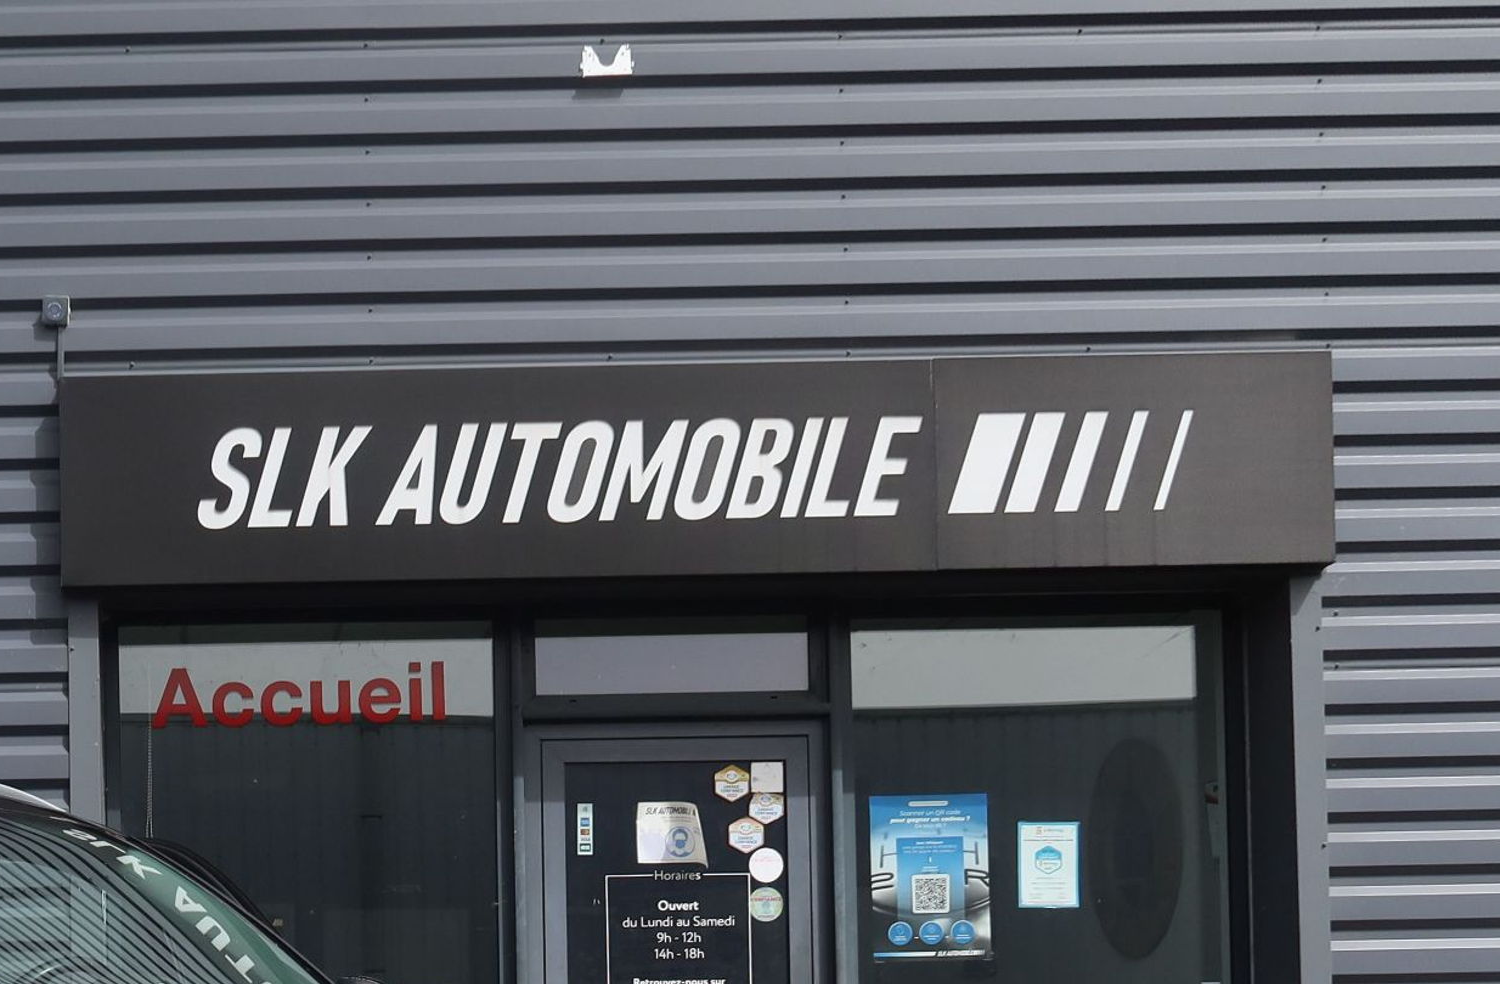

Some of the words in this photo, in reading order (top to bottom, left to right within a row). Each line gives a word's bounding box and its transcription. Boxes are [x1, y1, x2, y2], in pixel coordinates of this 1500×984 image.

[197, 426, 372, 529] SLK
[375, 416, 923, 526] AUTOMOBILE
[153, 661, 446, 729] Accueil
[654, 869, 701, 881] Horaires
[657, 900, 699, 911] Ouvert
[622, 916, 637, 928] du
[640, 916, 673, 928] Lundi
[676, 918, 690, 927] au
[693, 915, 735, 927] Samedi
[656, 932, 672, 943] 9h
[682, 931, 702, 943] 12h
[654, 948, 674, 959] 14h
[684, 947, 705, 959] 18h
